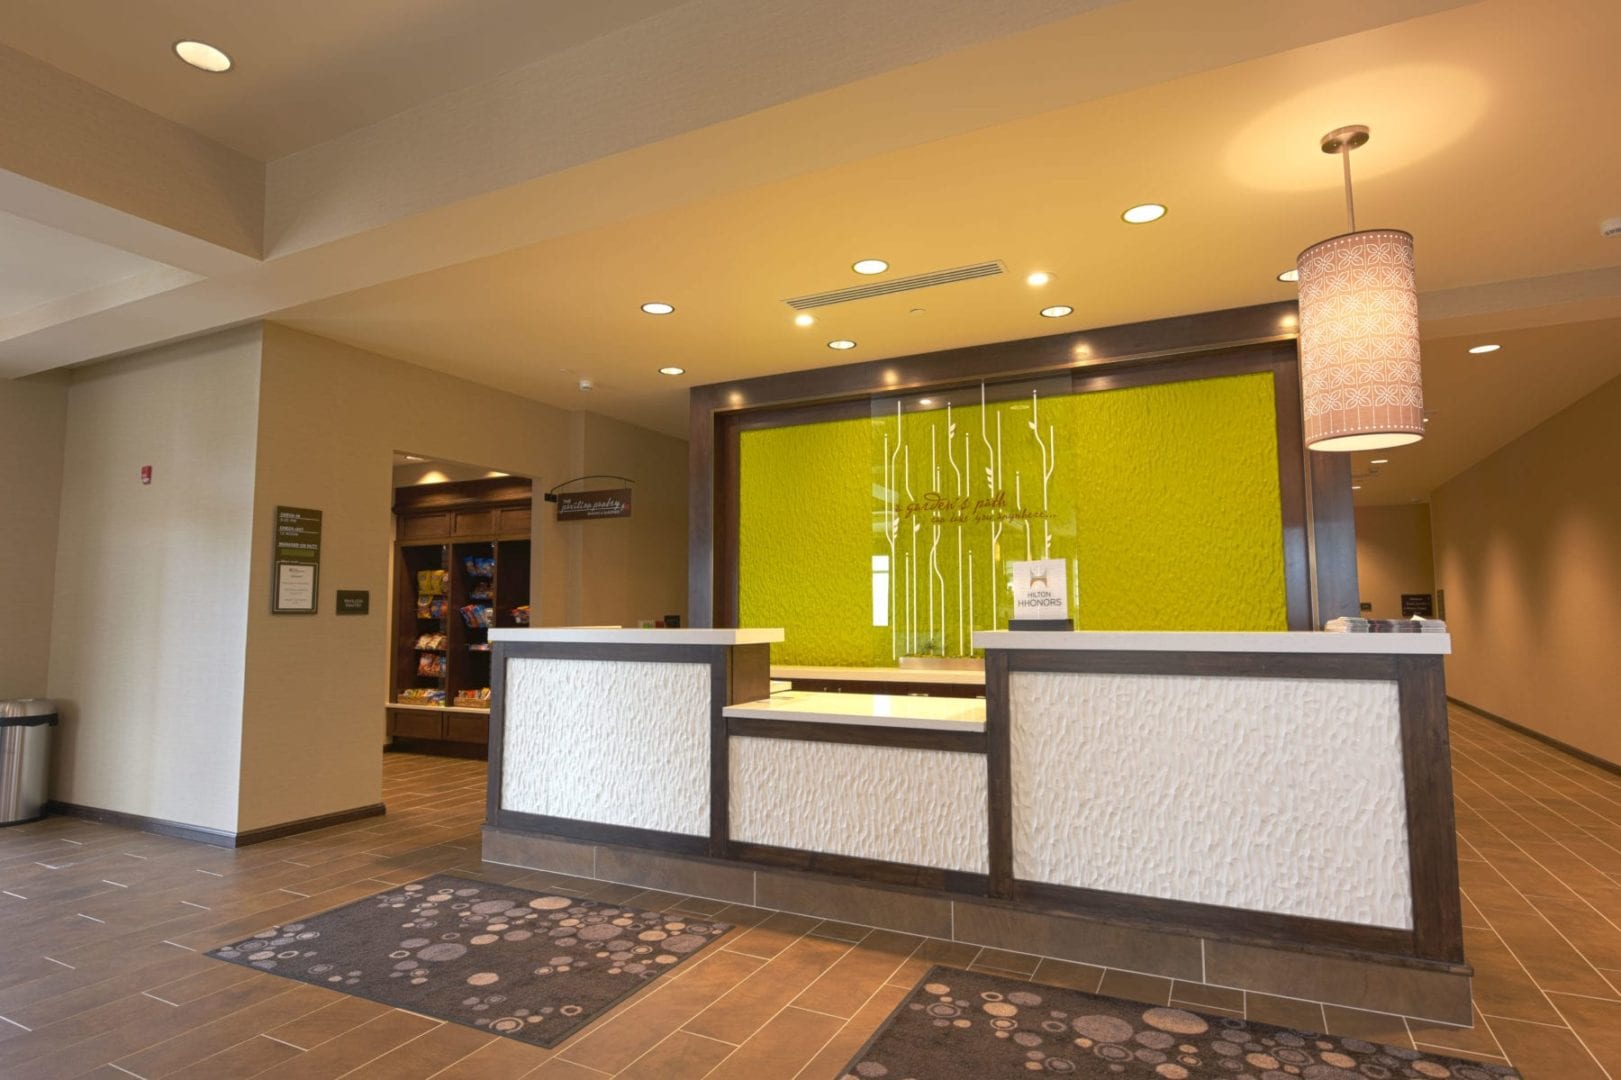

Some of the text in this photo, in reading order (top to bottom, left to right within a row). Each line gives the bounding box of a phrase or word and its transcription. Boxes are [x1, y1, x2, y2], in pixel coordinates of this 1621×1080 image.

[905, 492, 969, 518] garden's
[973, 491, 1006, 514] path
[975, 514, 993, 526] you
[1018, 598, 1062, 607] HHONORS
